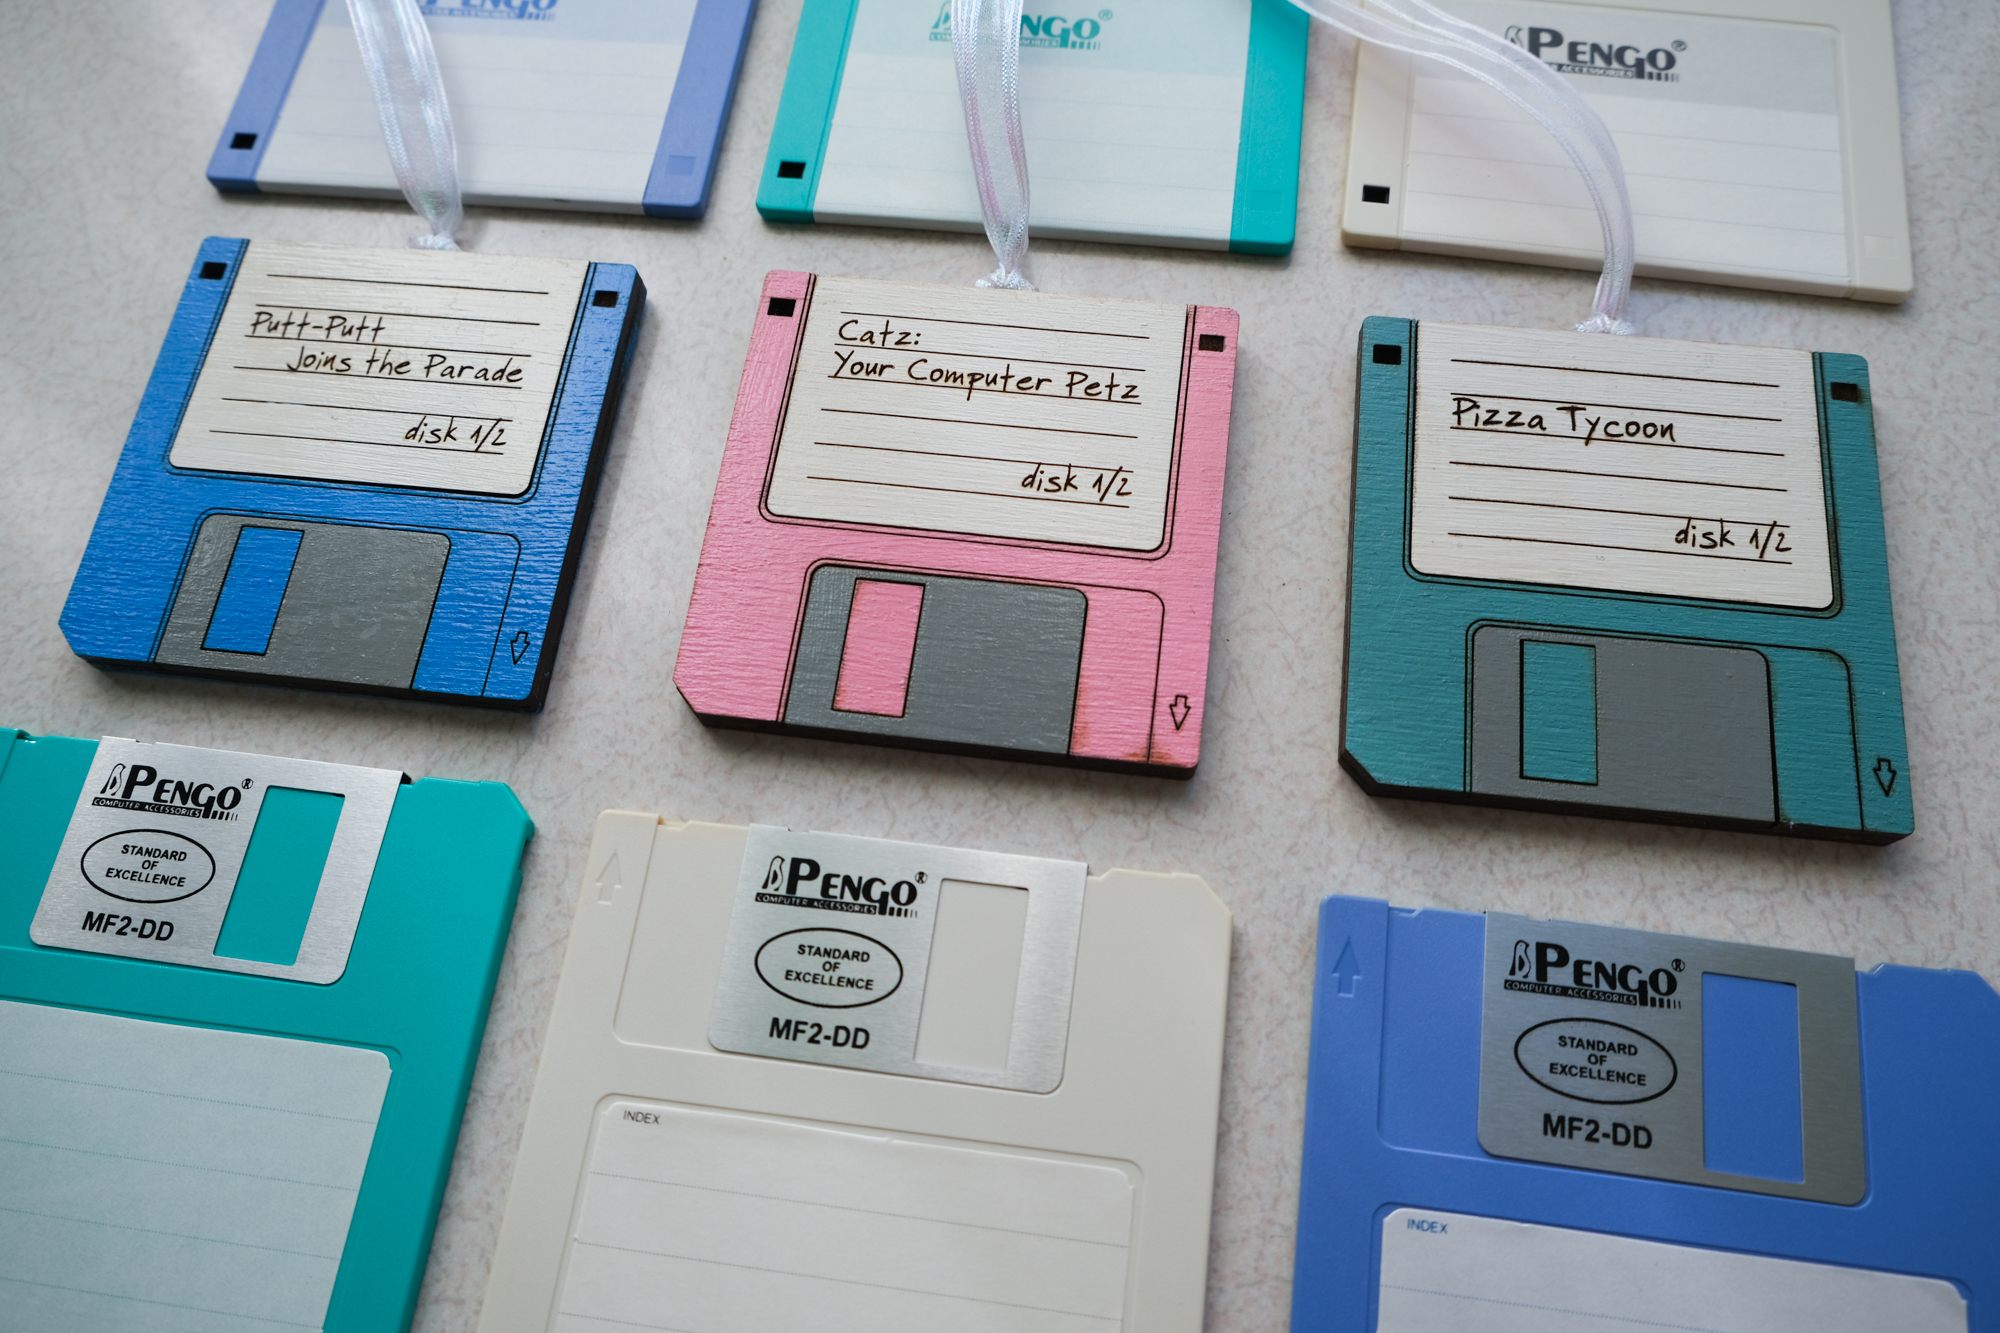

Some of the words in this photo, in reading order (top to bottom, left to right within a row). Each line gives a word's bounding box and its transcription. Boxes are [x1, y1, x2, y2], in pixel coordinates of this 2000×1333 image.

[1020, 14, 1101, 49] NGO
[1528, 26, 1676, 80] PENGO
[250, 310, 386, 343] Putt-Putt
[838, 319, 921, 348] Catz:
[286, 346, 352, 373] Joins
[365, 348, 412, 376] the
[424, 354, 524, 383] Parade
[833, 350, 895, 378] Your
[907, 358, 1053, 401] Computer
[1066, 371, 1140, 401] Petz
[404, 415, 458, 444] disk
[470, 418, 507, 452] 1/2
[1452, 397, 1547, 431] Pizza
[1556, 405, 1676, 446] Tycoon
[1021, 462, 1078, 492] disk
[1092, 466, 1132, 502] 1/2
[1674, 516, 1735, 549] disk
[1749, 520, 1793, 559] 1/2
[121, 764, 242, 819] PENGO
[93, 798, 141, 810] COMPUTER
[144, 804, 201, 818] ACCESSORIES
[121, 844, 187, 862] STANDARD
[141, 859, 159, 871] OF
[105, 867, 186, 887] EXCELLENCE
[785, 857, 918, 916] PENGO
[756, 894, 808, 906] COMPUTER
[813, 900, 876, 914] ACCESSORIES
[81, 911, 174, 941] MF2-DD
[797, 944, 870, 962] STANDARD
[822, 961, 841, 973] OF
[784, 969, 874, 990] EXCELLENCE
[1535, 941, 1678, 1007] PENGO
[1505, 980, 1562, 995] COMPUTER
[1567, 988, 1637, 1005] ACCESSORIES
[769, 1017, 870, 1049] MF2-DD
[1558, 1035, 1638, 1056] STANDARD
[1549, 1062, 1647, 1086] EXCELLENCE
[1587, 1053, 1607, 1066] OF
[622, 1109, 661, 1125] INDEX
[1543, 1112, 1653, 1149] MF2-DD
[1406, 1218, 1448, 1234] INDEX
